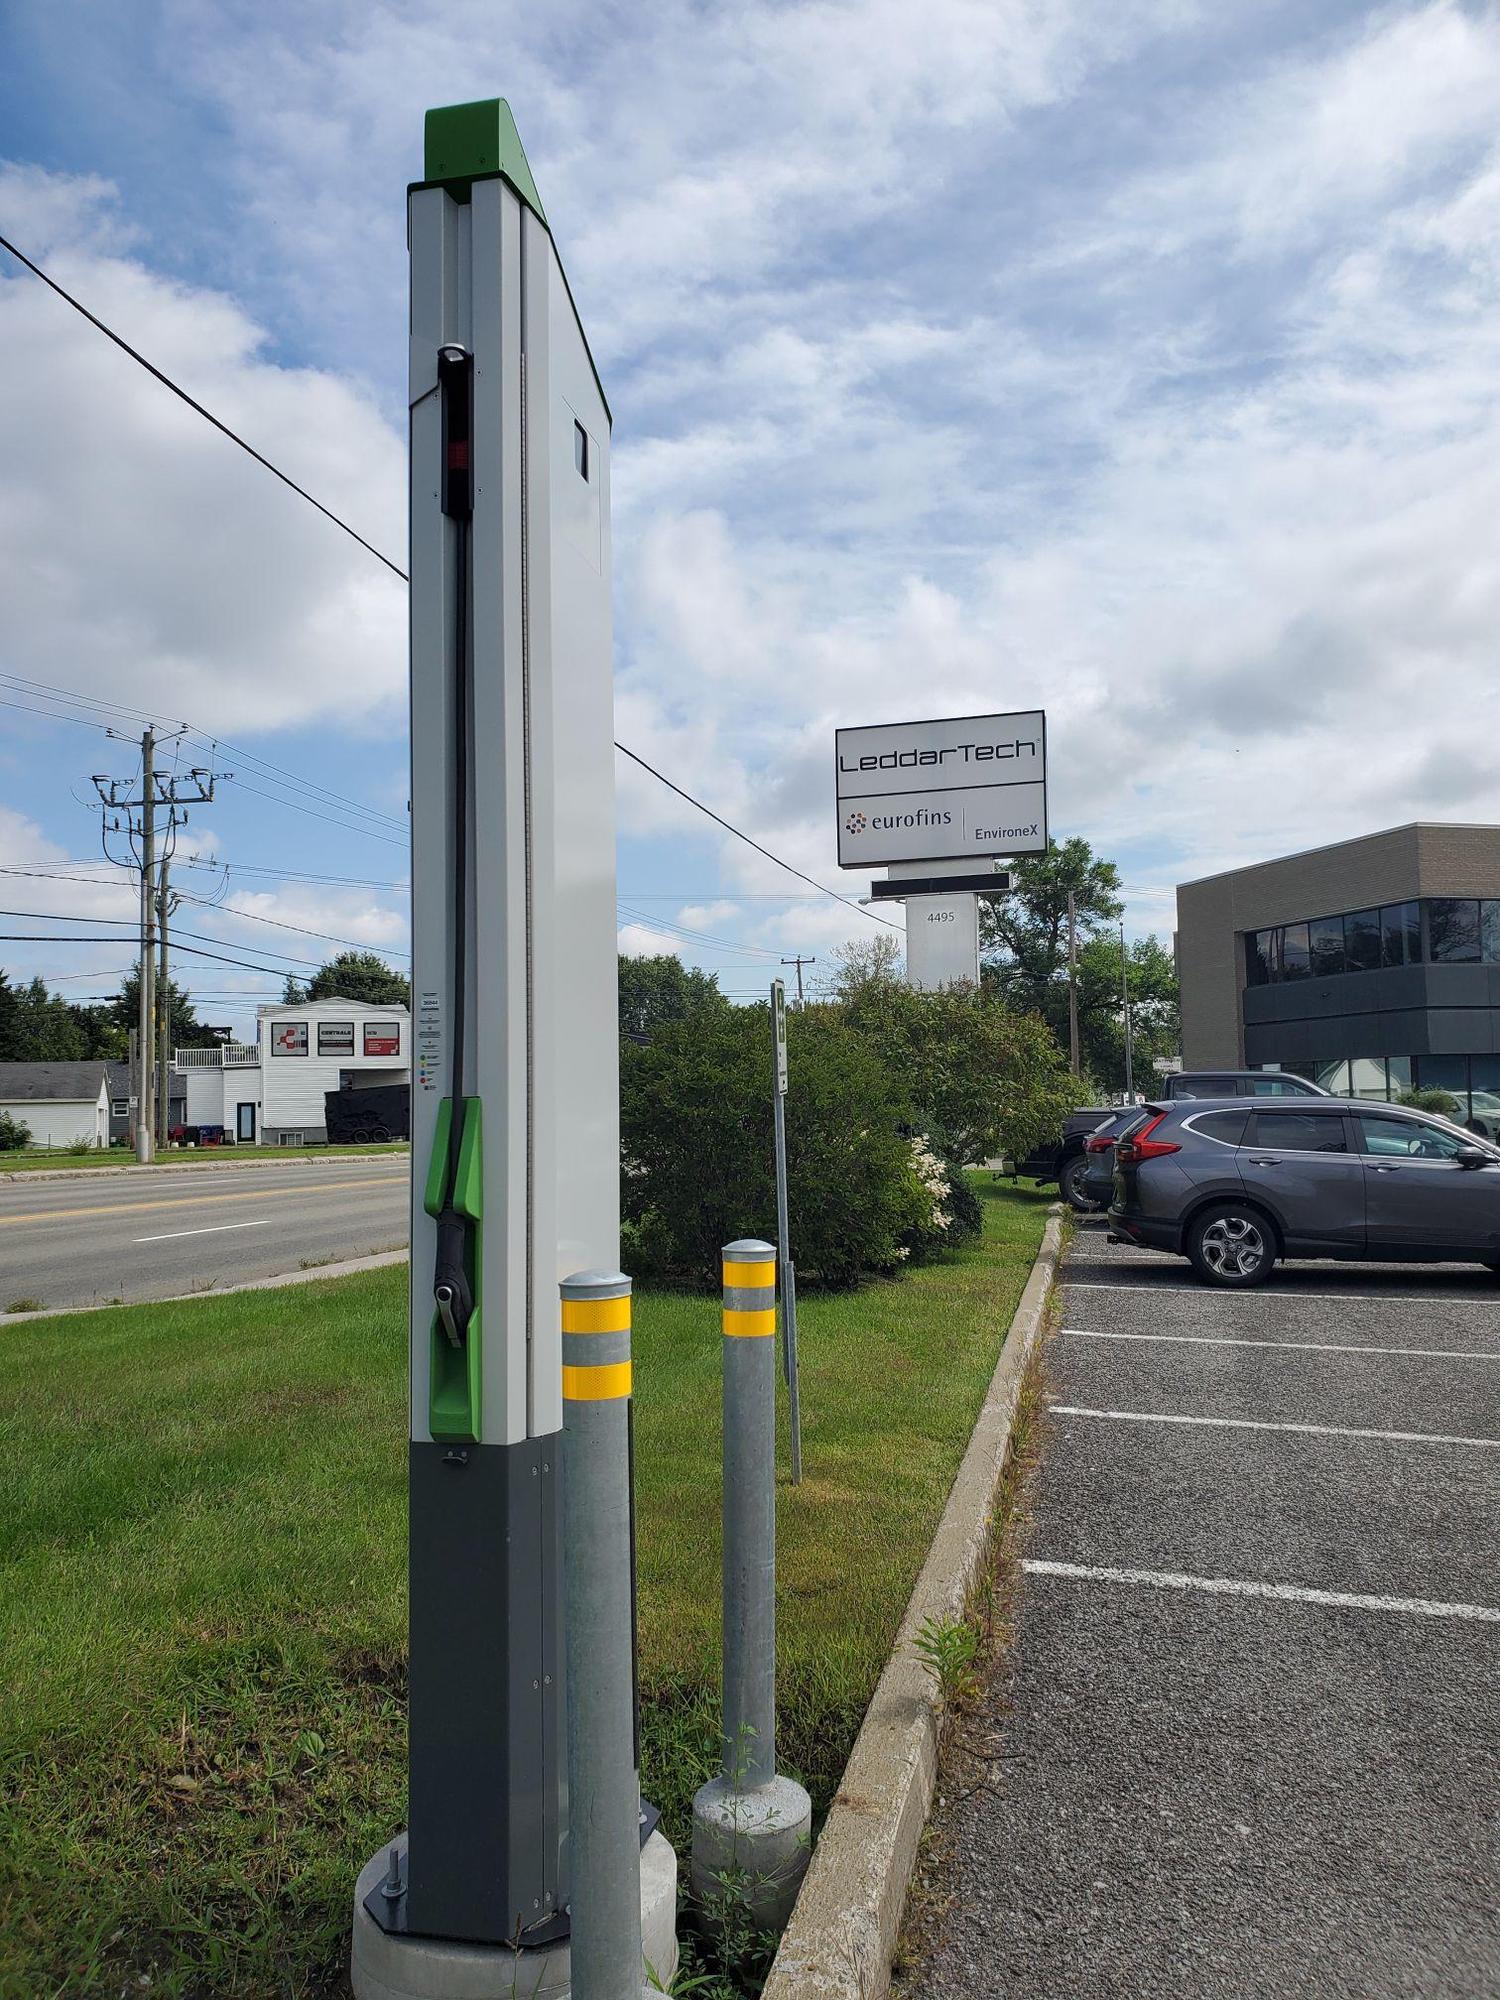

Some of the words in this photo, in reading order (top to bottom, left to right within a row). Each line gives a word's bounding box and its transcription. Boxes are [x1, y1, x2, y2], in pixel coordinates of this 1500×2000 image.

[840, 739, 1036, 773] LeddarTech
[872, 808, 952, 830] eurofins
[975, 823, 1038, 840] EnvironeX
[927, 911, 955, 923] 4495
